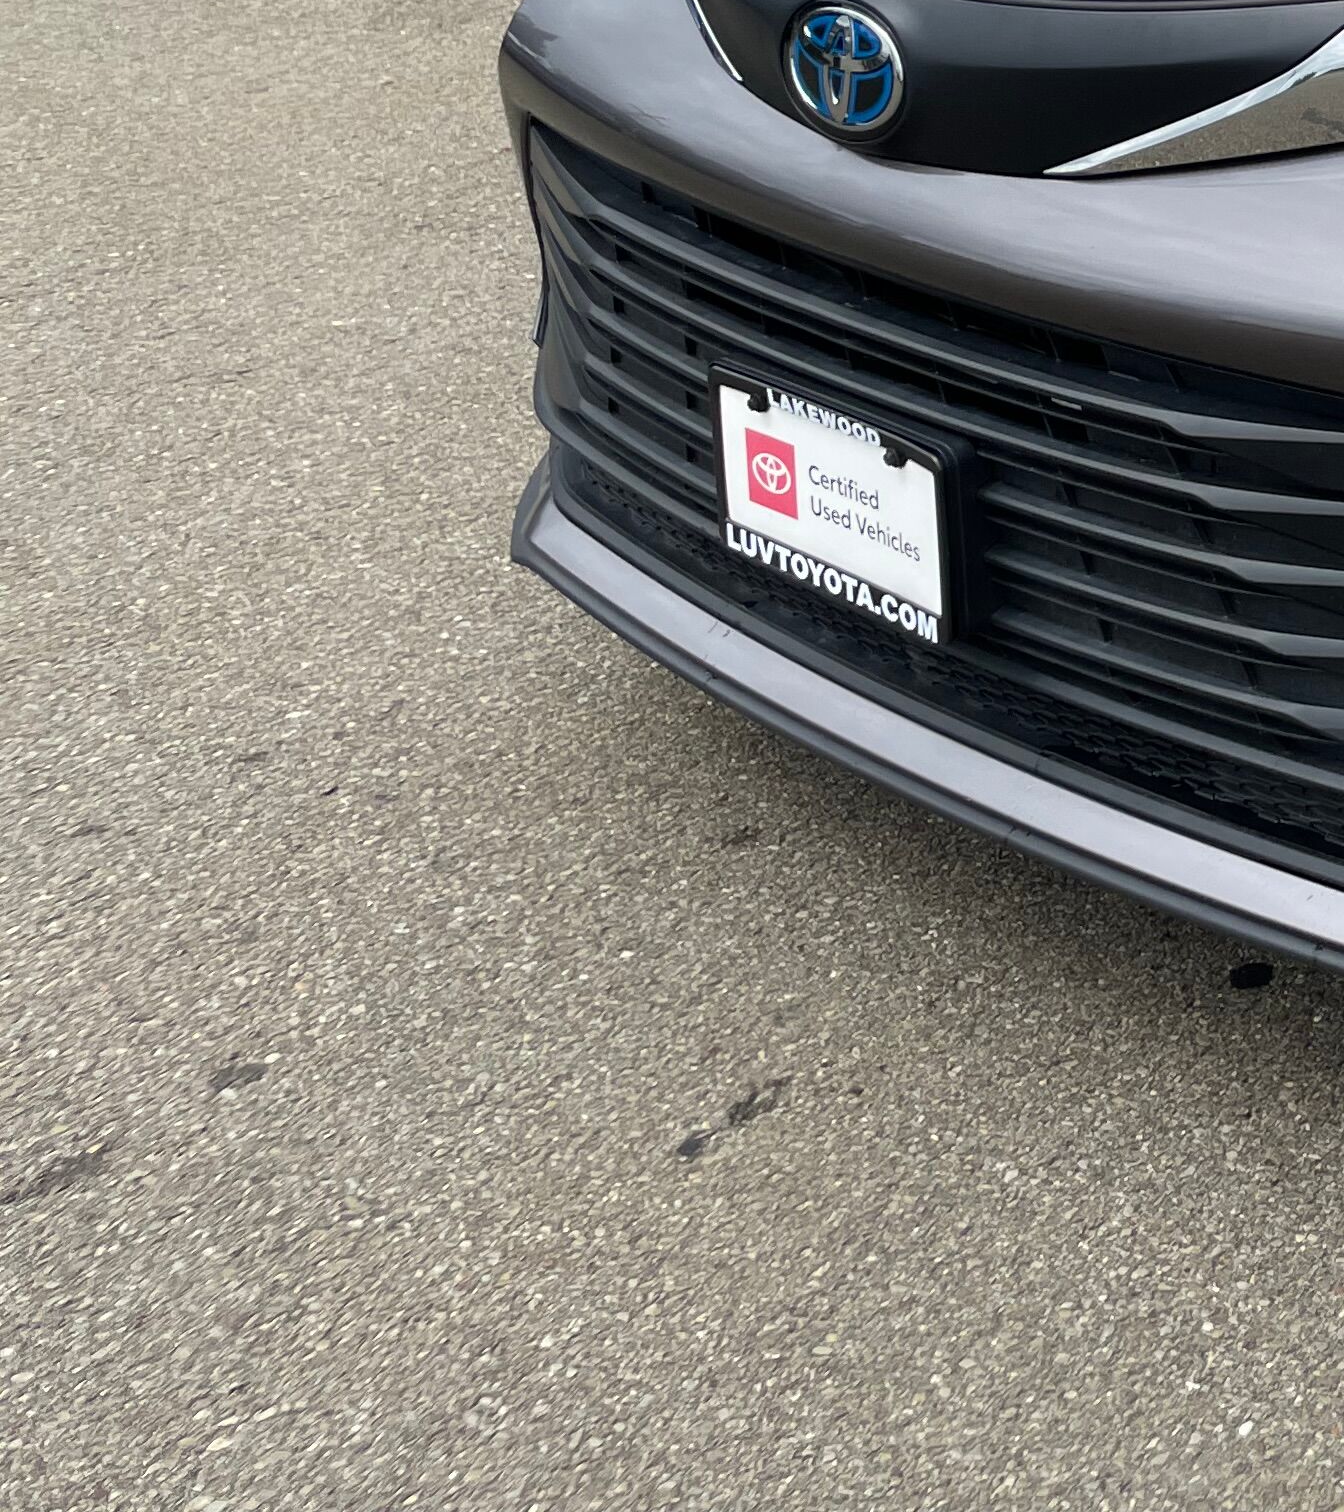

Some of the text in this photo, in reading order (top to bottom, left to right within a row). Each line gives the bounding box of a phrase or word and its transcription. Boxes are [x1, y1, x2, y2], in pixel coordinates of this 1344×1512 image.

[766, 387, 881, 447] LAKEWOOD
[808, 464, 880, 511] Certified
[811, 495, 921, 563] Used Vehicles
[725, 522, 939, 644] LUVTOYOTA.COM
